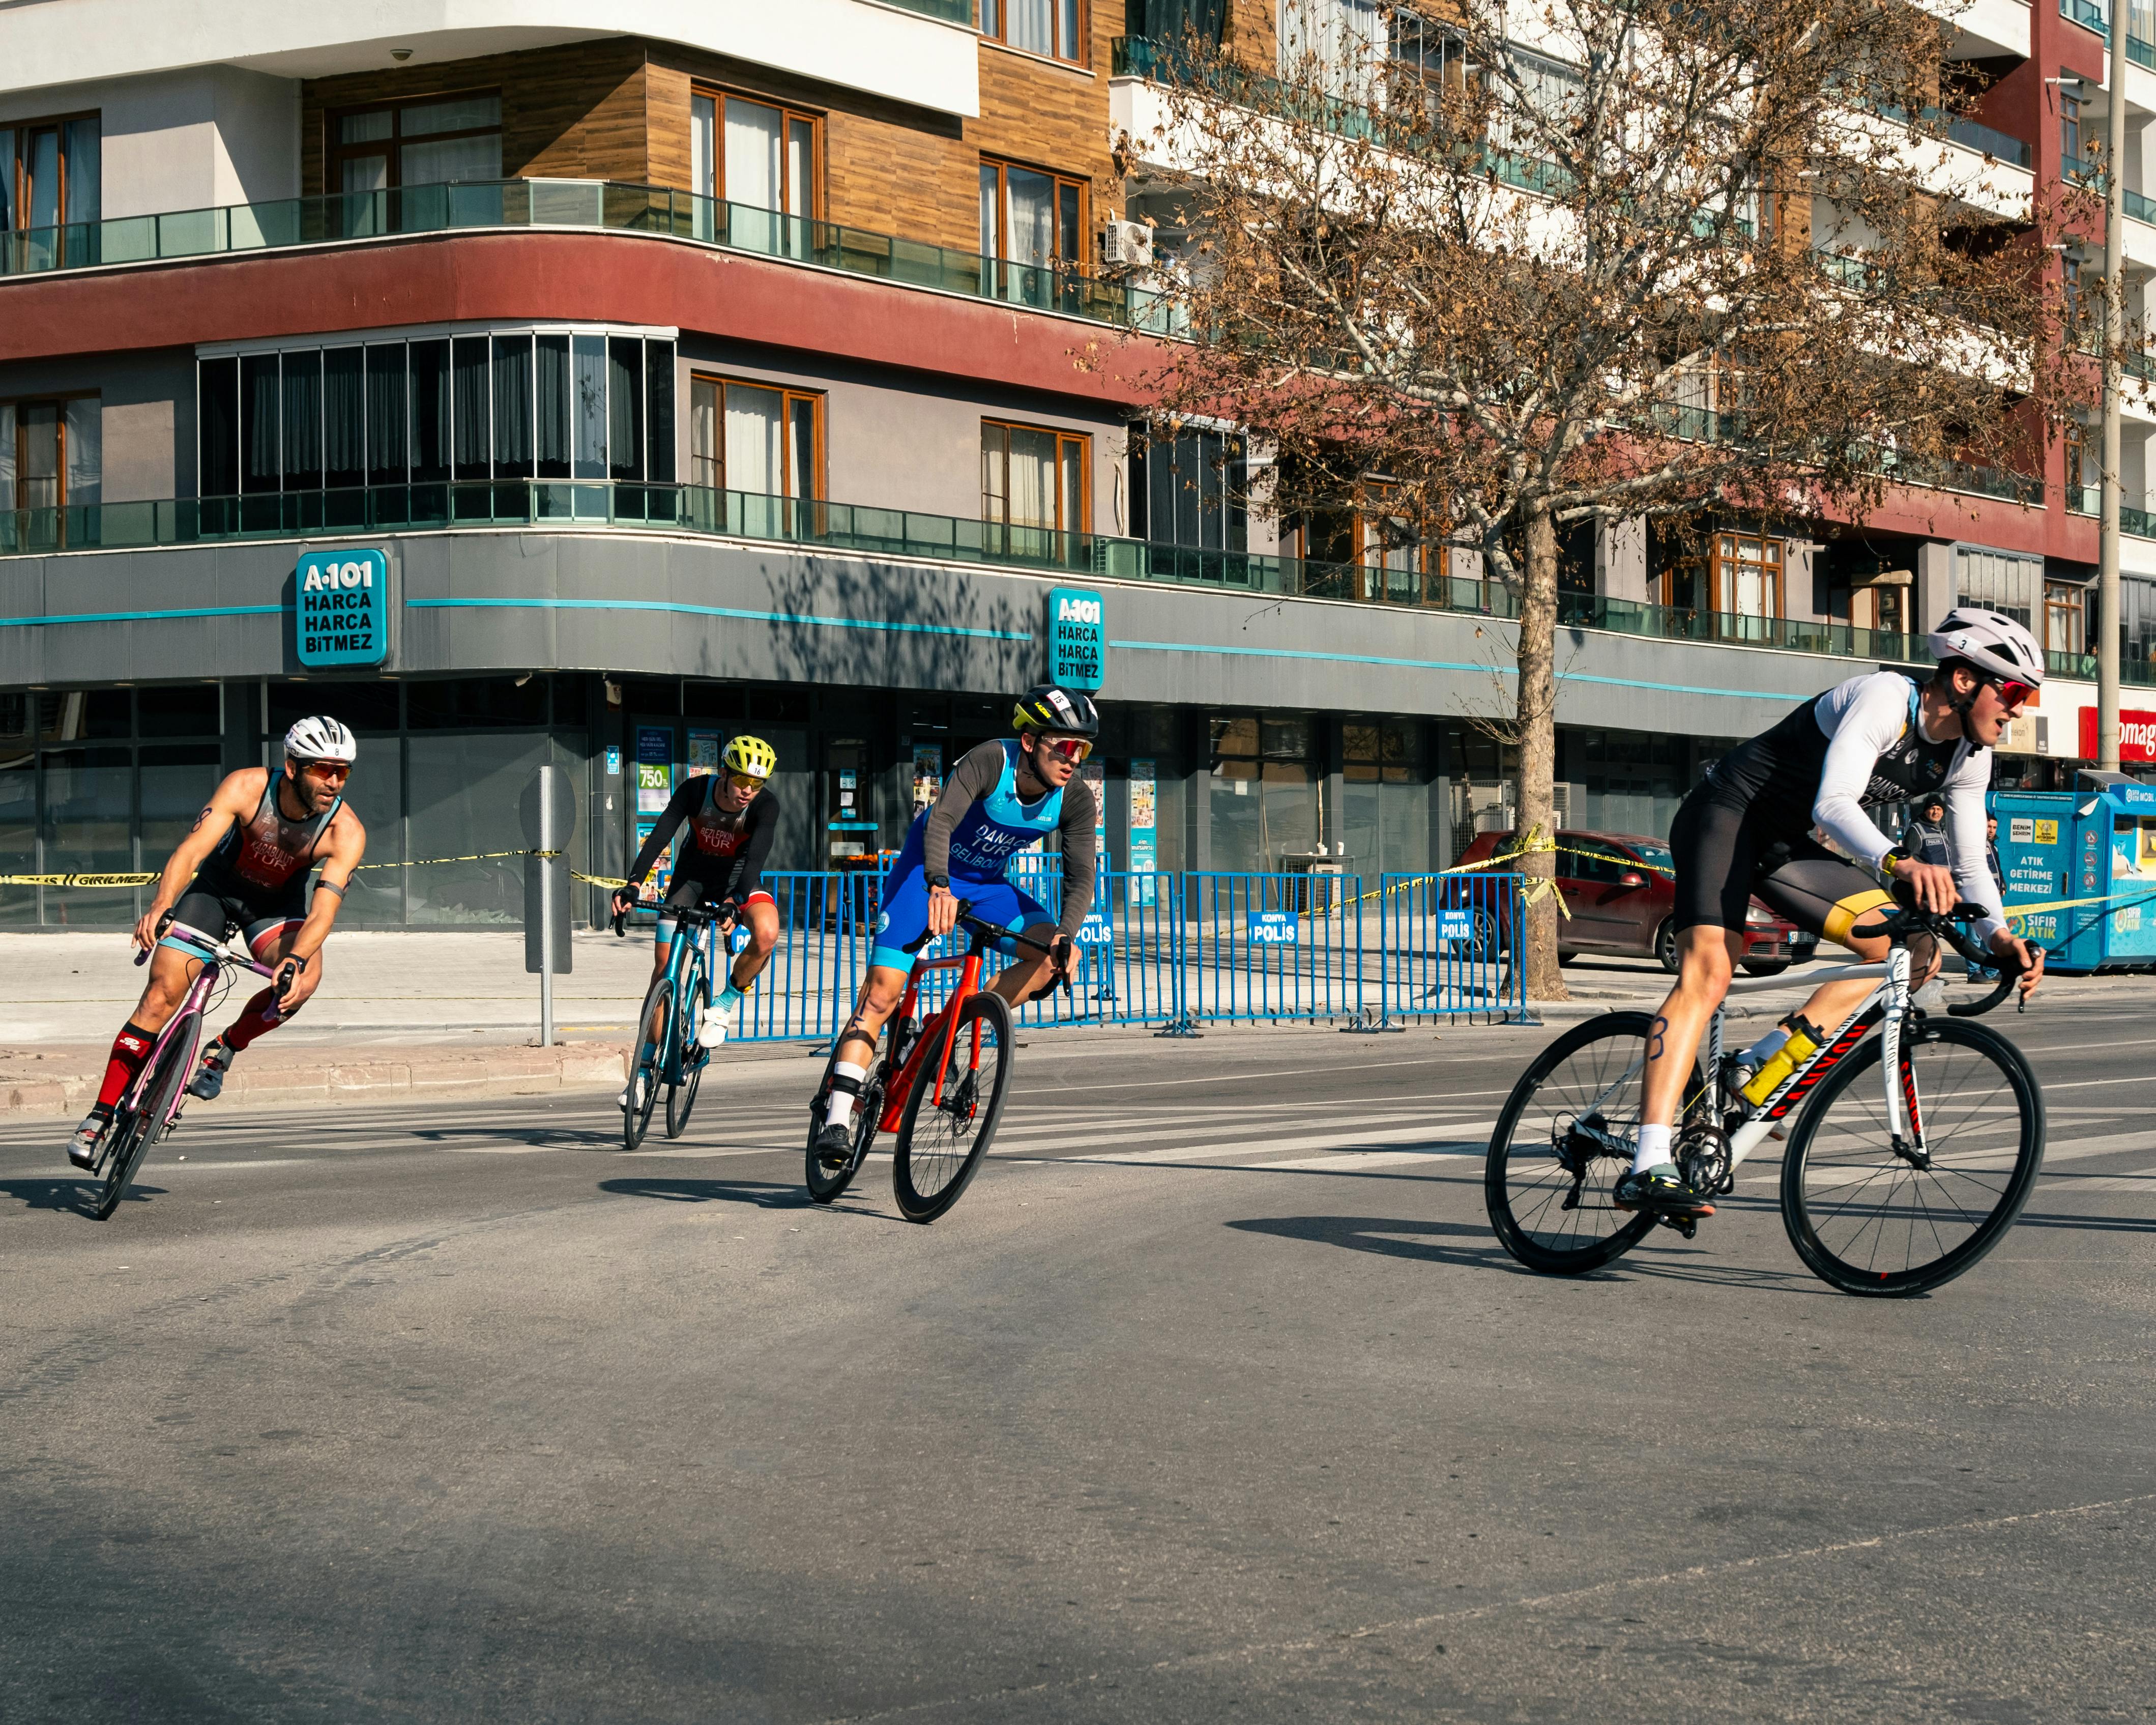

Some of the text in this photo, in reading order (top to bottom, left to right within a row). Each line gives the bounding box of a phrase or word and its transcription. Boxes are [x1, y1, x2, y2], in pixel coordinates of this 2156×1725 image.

[305, 592, 372, 611] HARCA
[305, 613, 372, 632] HARCA
[1058, 626, 1098, 642] HARCA
[1959, 640, 1967, 650] 3
[1058, 644, 1098, 660] HARCA
[1054, 696, 1064, 704] 15
[335, 748, 339, 756] 8
[754, 767, 761, 775] 16
[640, 769, 663, 787] 750
[191, 807, 213, 833] 8
[700, 827, 735, 842] BEZLEPKIN
[703, 835, 730, 849] TUR
[971, 836, 1010, 856] TUR
[251, 840, 295, 866] KARABULUT
[253, 849, 287, 871] TUR
[2020, 856, 2044, 867] ATIK
[2010, 868, 2053, 881] GETİRME
[2009, 882, 2053, 894] MERKEZİ
[1083, 914, 1103, 923] ONYA
[1262, 914, 1287, 923] KONYA
[1445, 911, 1465, 920] KONYA
[2128, 907, 2141, 918] SIFIR
[2027, 915, 2057, 927] SIFIR
[2127, 918, 2140, 930] ATIK
[1254, 923, 1295, 942] POLİS
[1441, 921, 1470, 938] POLİS
[2027, 927, 2056, 939] ATIK
[1792, 933, 1797, 941] 42
[1650, 1017, 1668, 1061] 3
[1770, 1025, 1869, 1117] CANYON
